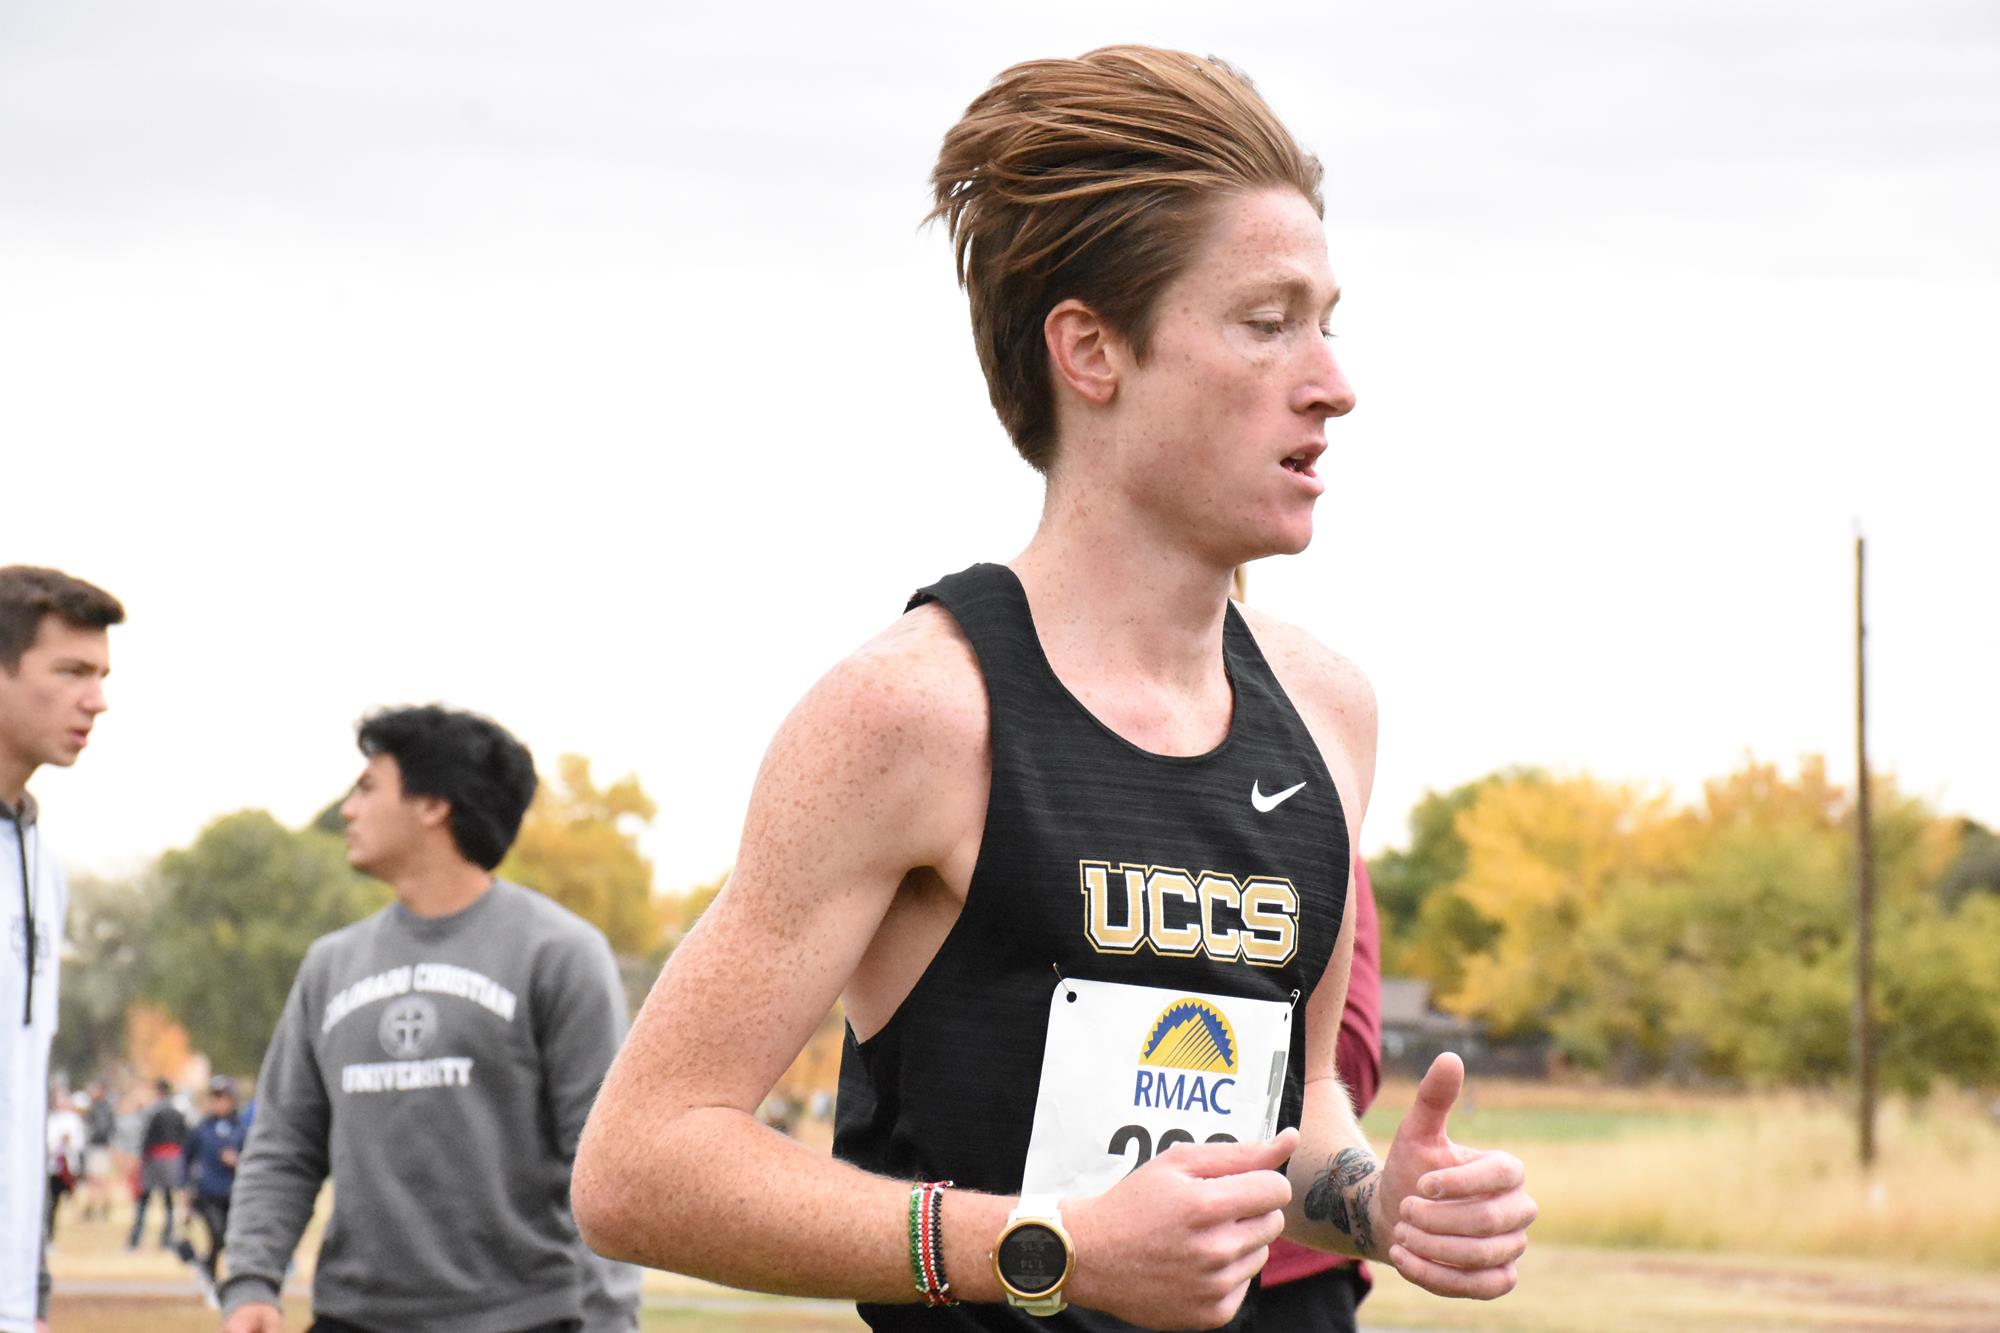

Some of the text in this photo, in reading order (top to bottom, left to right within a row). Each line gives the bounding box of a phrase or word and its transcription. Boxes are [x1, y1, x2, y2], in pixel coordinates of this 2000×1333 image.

[1080, 860, 1299, 968] UCCS
[322, 963, 517, 1034] COLORADO CHRISTIAN
[342, 1057, 474, 1093] UNIVERSITY
[1134, 1070, 1236, 1115] RMAC
